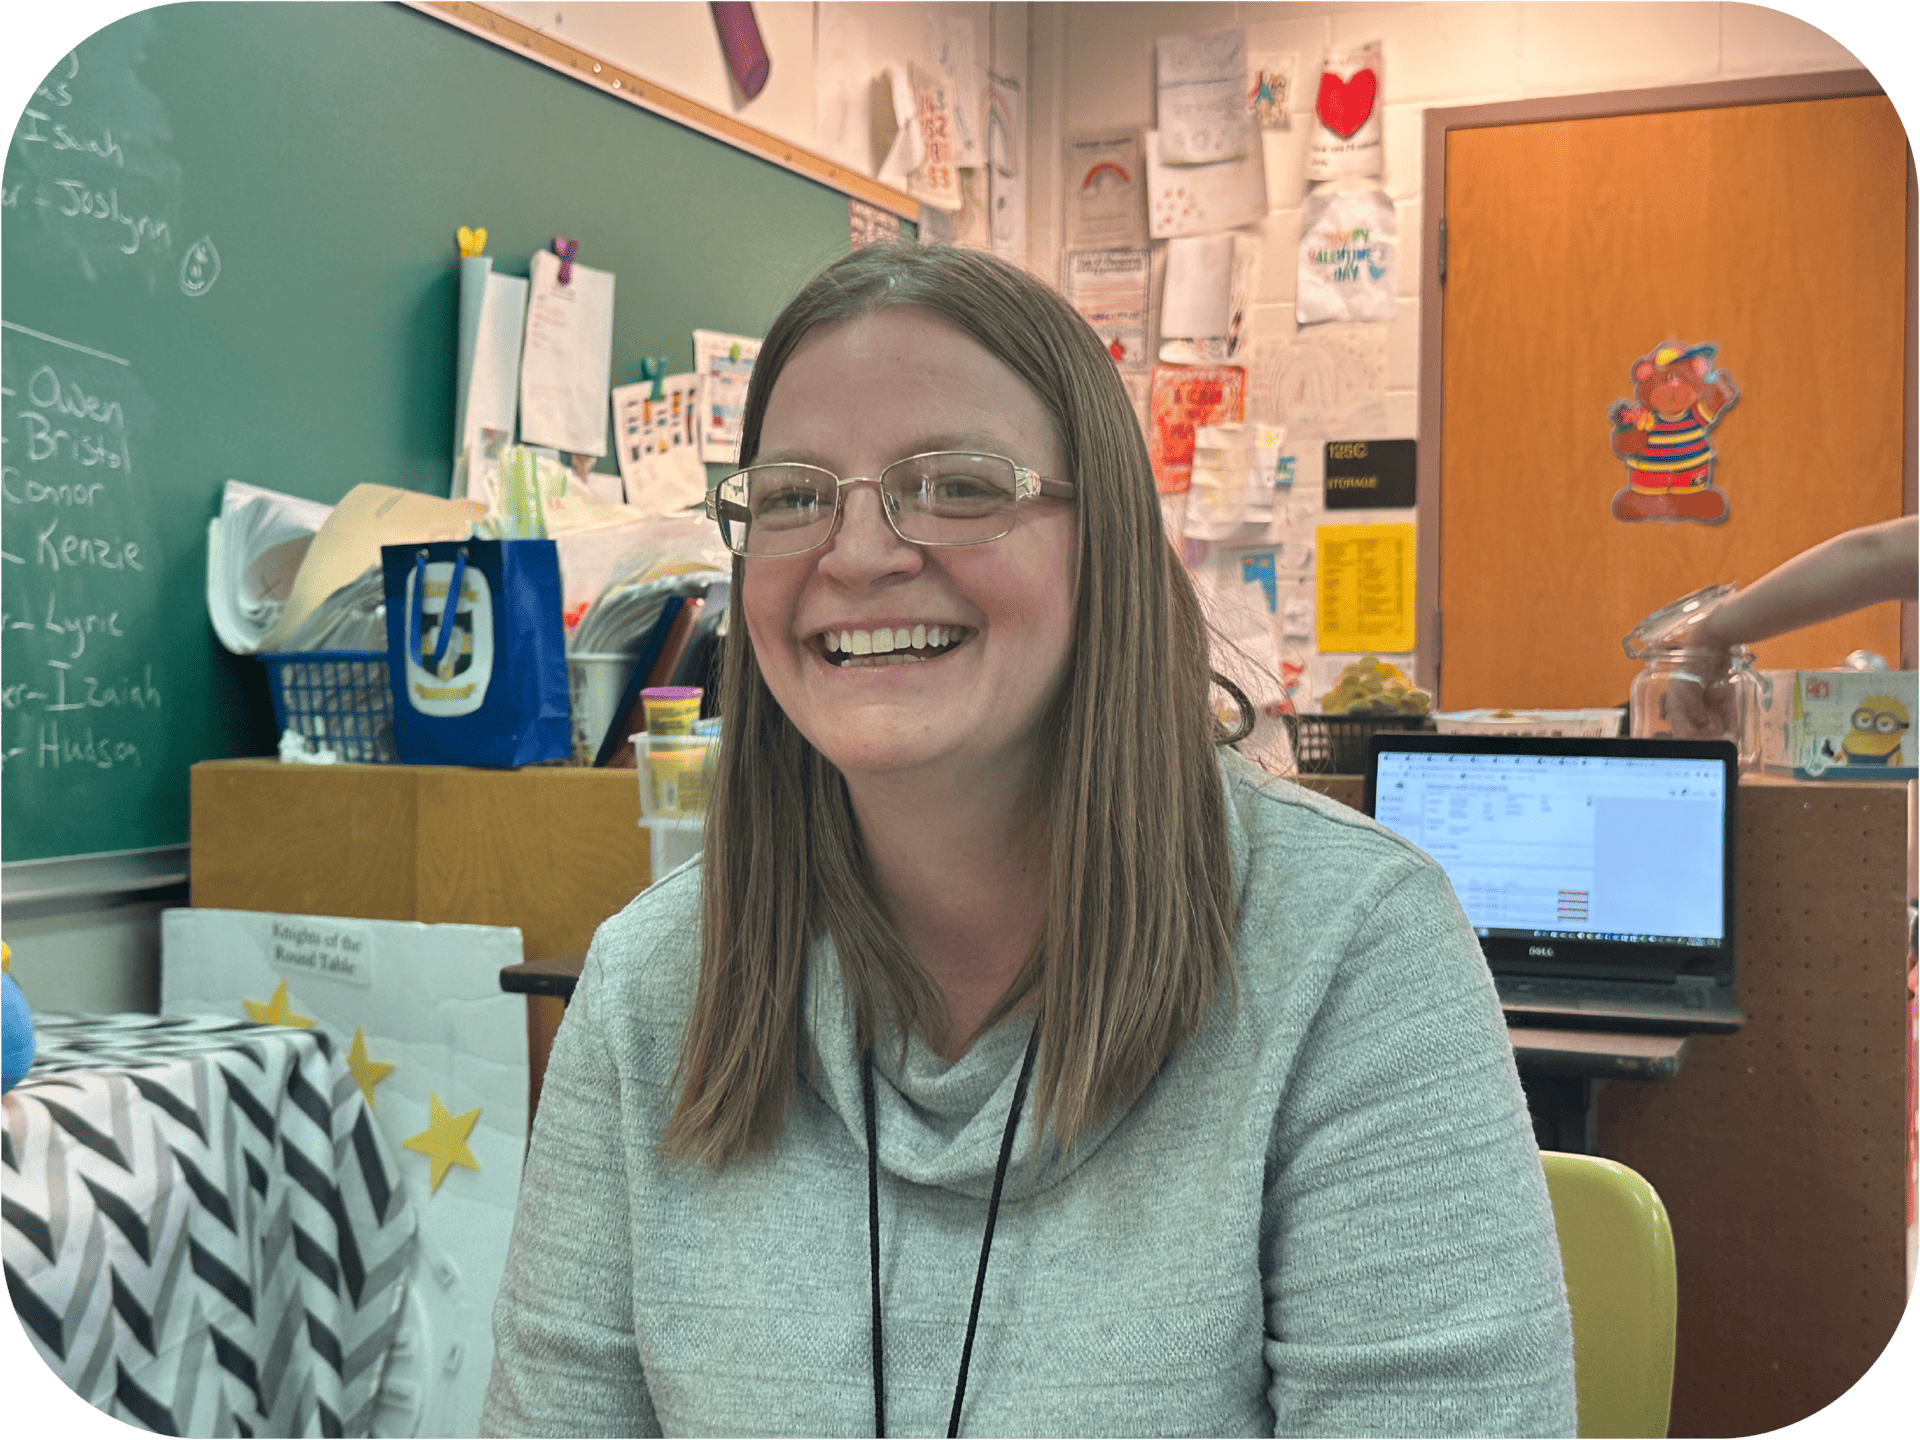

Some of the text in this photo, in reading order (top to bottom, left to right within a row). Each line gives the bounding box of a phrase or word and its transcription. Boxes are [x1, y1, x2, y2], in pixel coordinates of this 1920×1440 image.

[28, 364, 124, 428] Owen
[272, 920, 362, 953] Knights of the
[275, 944, 356, 974] Round Table
